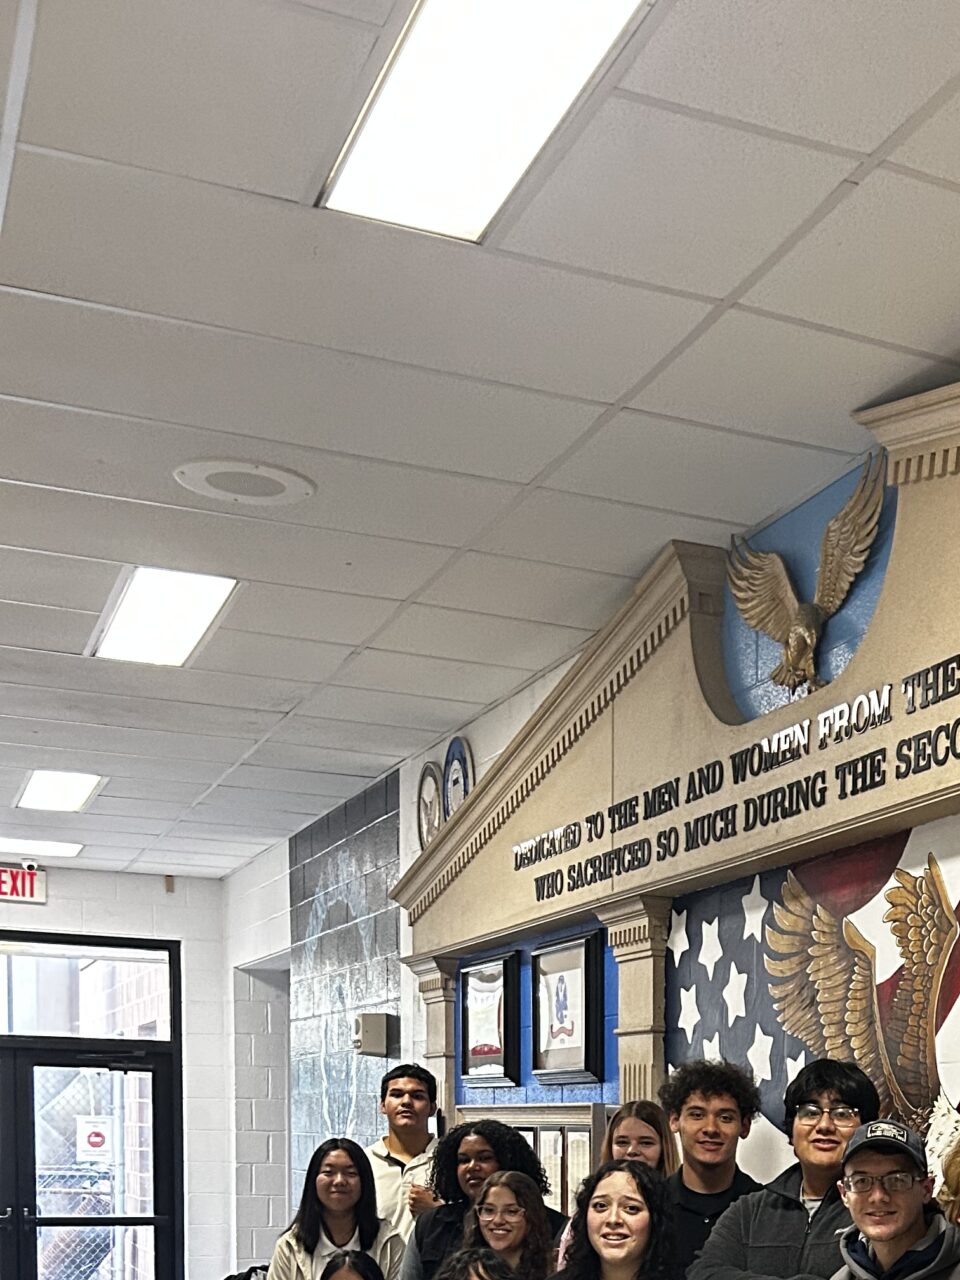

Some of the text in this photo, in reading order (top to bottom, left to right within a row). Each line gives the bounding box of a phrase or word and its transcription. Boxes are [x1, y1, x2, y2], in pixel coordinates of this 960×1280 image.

[512, 820, 582, 872] DEDICATED
[584, 811, 605, 843] TO
[607, 796, 640, 834] THE
[642, 777, 681, 820] MEN
[685, 760, 724, 804] AND
[730, 719, 811, 785] WOMEN
[817, 683, 893, 750] FROM
[534, 869, 564, 902] WHO
[567, 838, 652, 892] SACRIFICED
[656, 826, 679, 861] SO
[684, 803, 738, 852] MUCH
[743, 770, 828, 832] DURING
[835, 747, 887, 800] THE
[0, 868, 37, 898] EXIT
